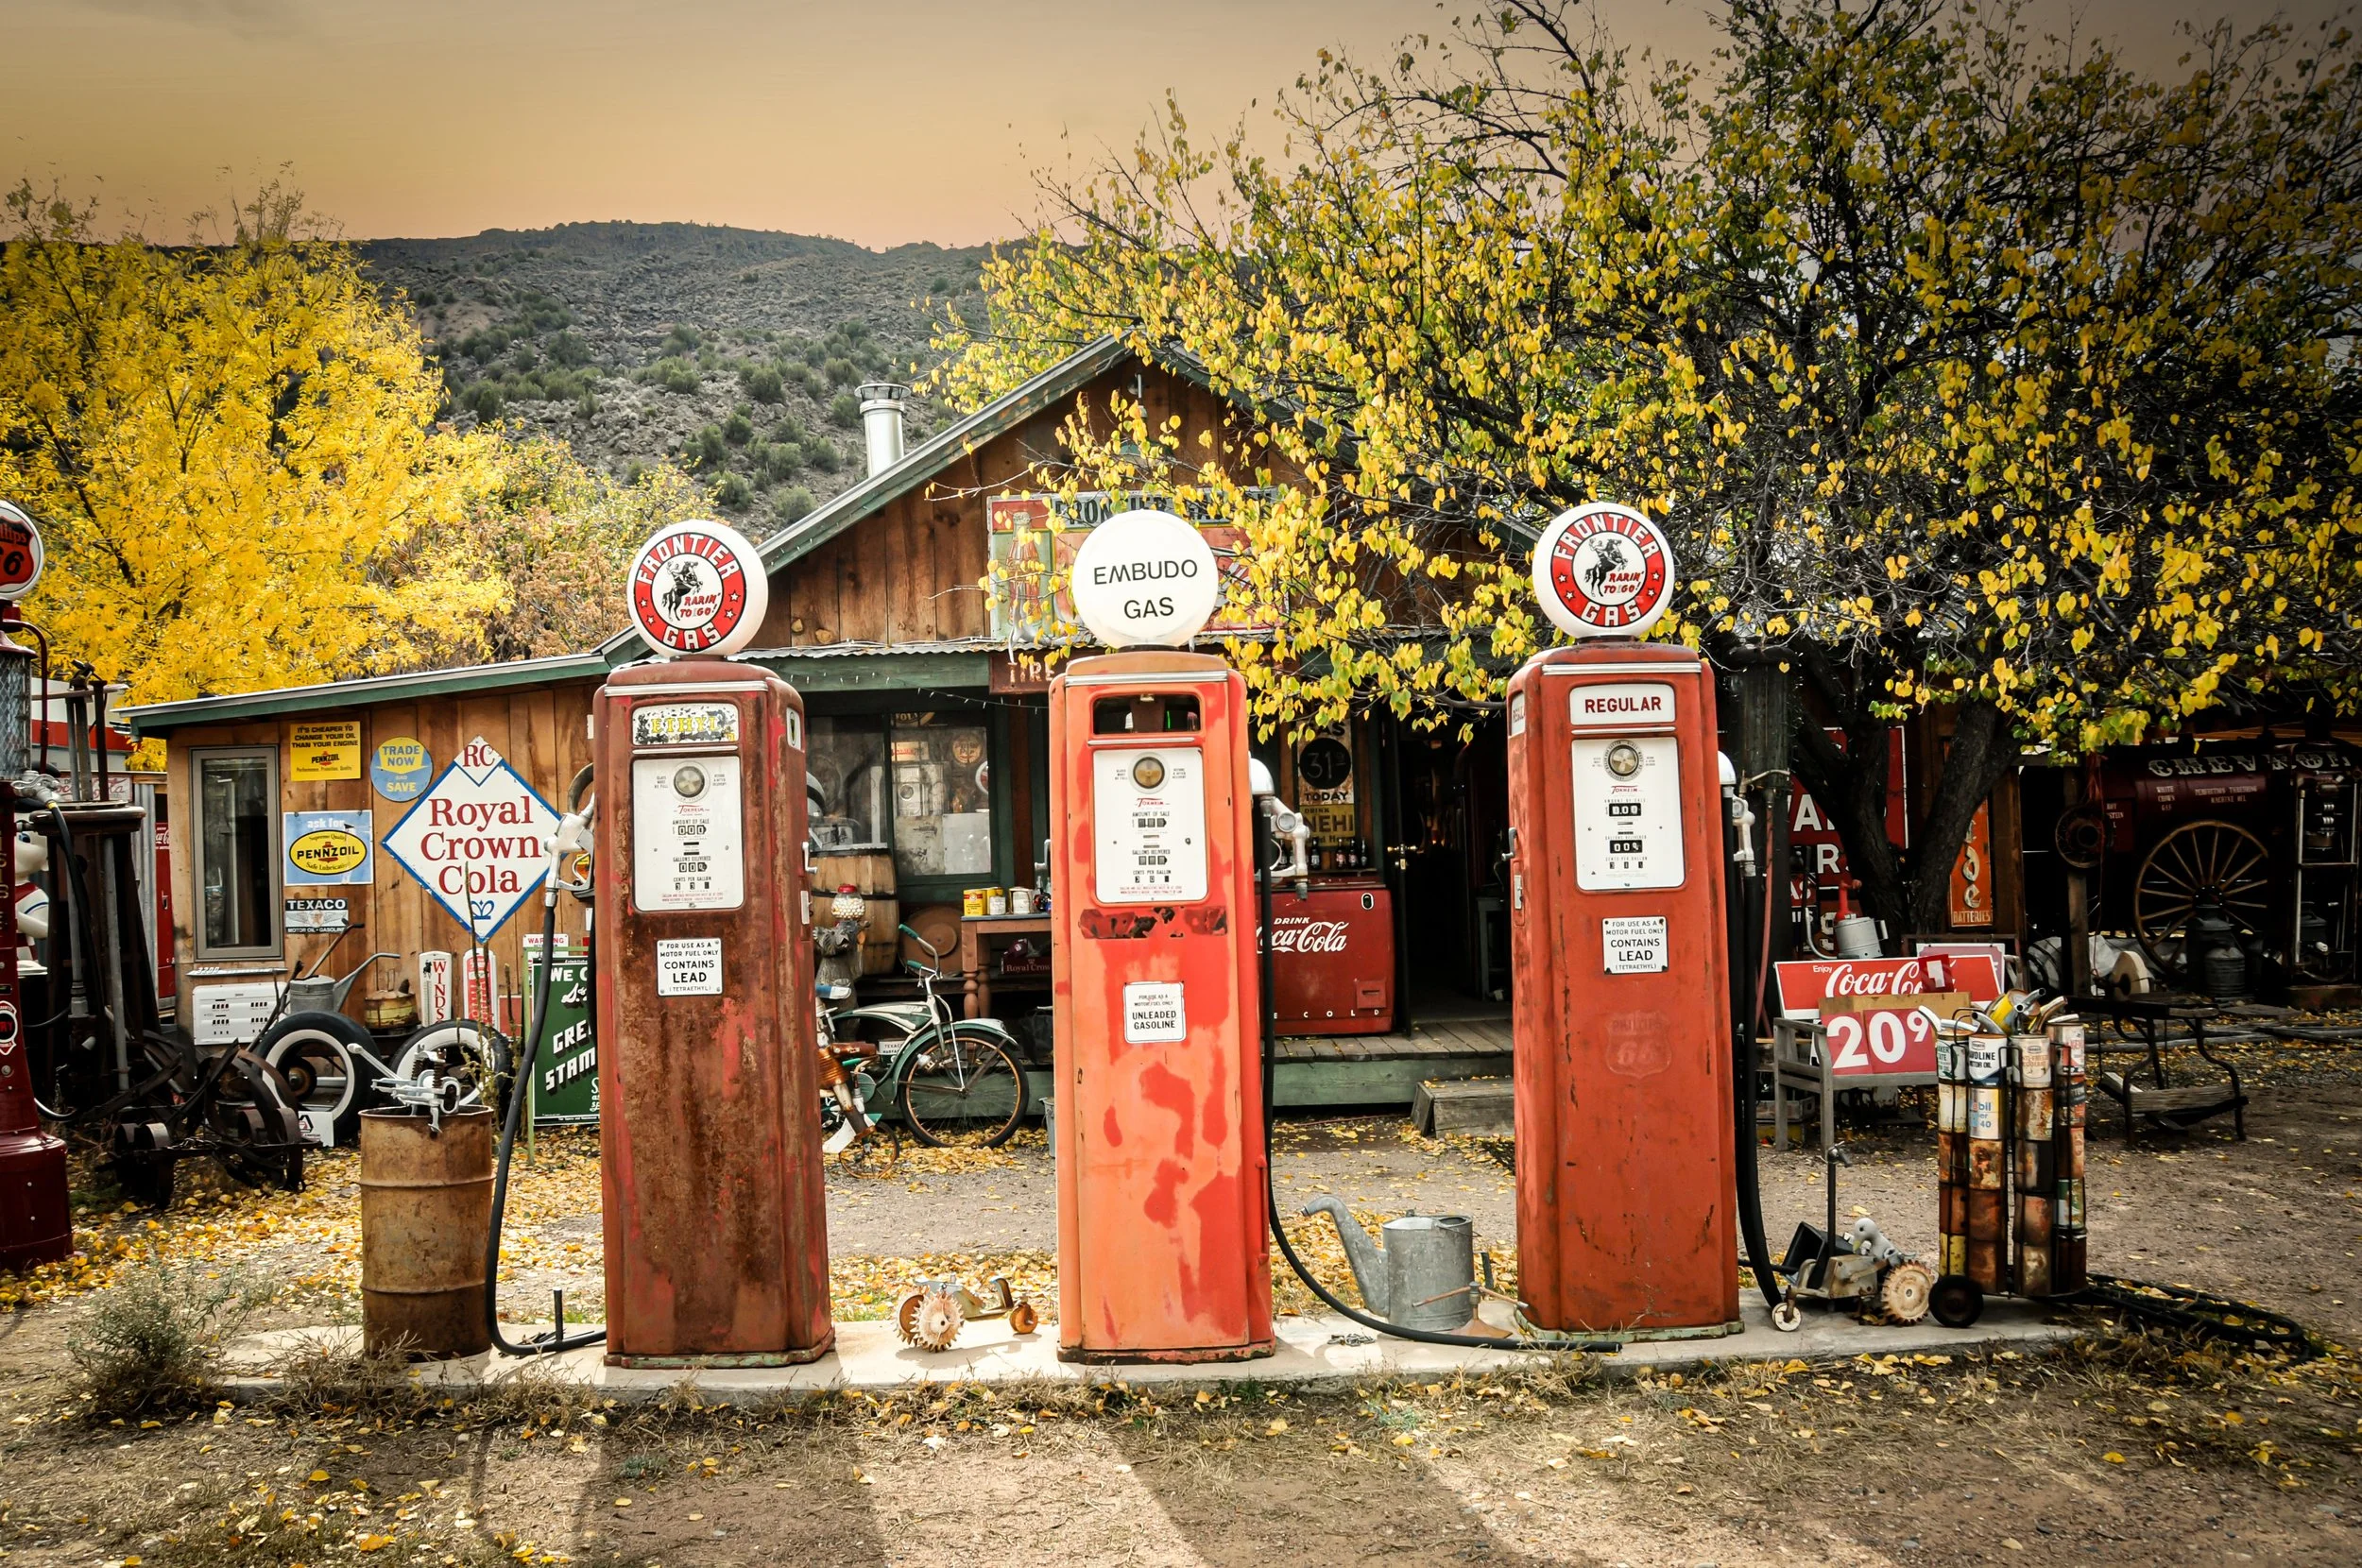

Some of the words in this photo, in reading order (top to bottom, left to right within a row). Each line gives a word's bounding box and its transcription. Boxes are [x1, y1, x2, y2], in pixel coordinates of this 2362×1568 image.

[1553, 513, 1659, 560] FRONTIER
[637, 535, 740, 585] FRONTIER
[1094, 558, 1198, 585] EMBUDO
[1609, 571, 1644, 583] RARIN'
[1604, 586, 1616, 594] TO
[1620, 582, 1641, 593] GO!
[684, 592, 721, 605] RARIN'
[680, 608, 692, 618] TO
[696, 604, 717, 617] GO!
[1123, 597, 1174, 619] GAS
[1581, 602, 1641, 626] GAS
[663, 622, 721, 650] GAS
[1584, 697, 1662, 713] REGULAR
[383, 745, 420, 756] TRADE
[462, 744, 495, 767] RC
[311, 753, 340, 764] PENNZOIL
[387, 757, 415, 767] NOW
[386, 782, 417, 793] SAVE
[1305, 792, 1349, 802] TODAY
[428, 795, 534, 832] Royal
[307, 817, 326, 828] ask
[297, 845, 360, 861] PENNZOIL
[420, 832, 542, 861] Crown
[438, 865, 522, 895] Cola
[286, 899, 346, 911] TEXACO
[1953, 910, 1992, 924] BATTERIES
[1610, 938, 1660, 948] CONTAINS
[1618, 950, 1653, 962] LEAD
[664, 960, 715, 970] CONTAINS
[1006, 964, 1030, 973] Royal
[1031, 963, 1051, 972] Crow
[1813, 964, 1833, 973] Enjoy
[550, 966, 573, 982] WE
[673, 972, 707, 983] LEAD
[1926, 960, 1945, 988] 1
[432, 961, 447, 1022] WINDS
[1132, 1010, 1177, 1020] UNLEADED
[1134, 1020, 1176, 1031] GASOLINE
[553, 1019, 592, 1055] GRE
[545, 1048, 596, 1092] STAM
